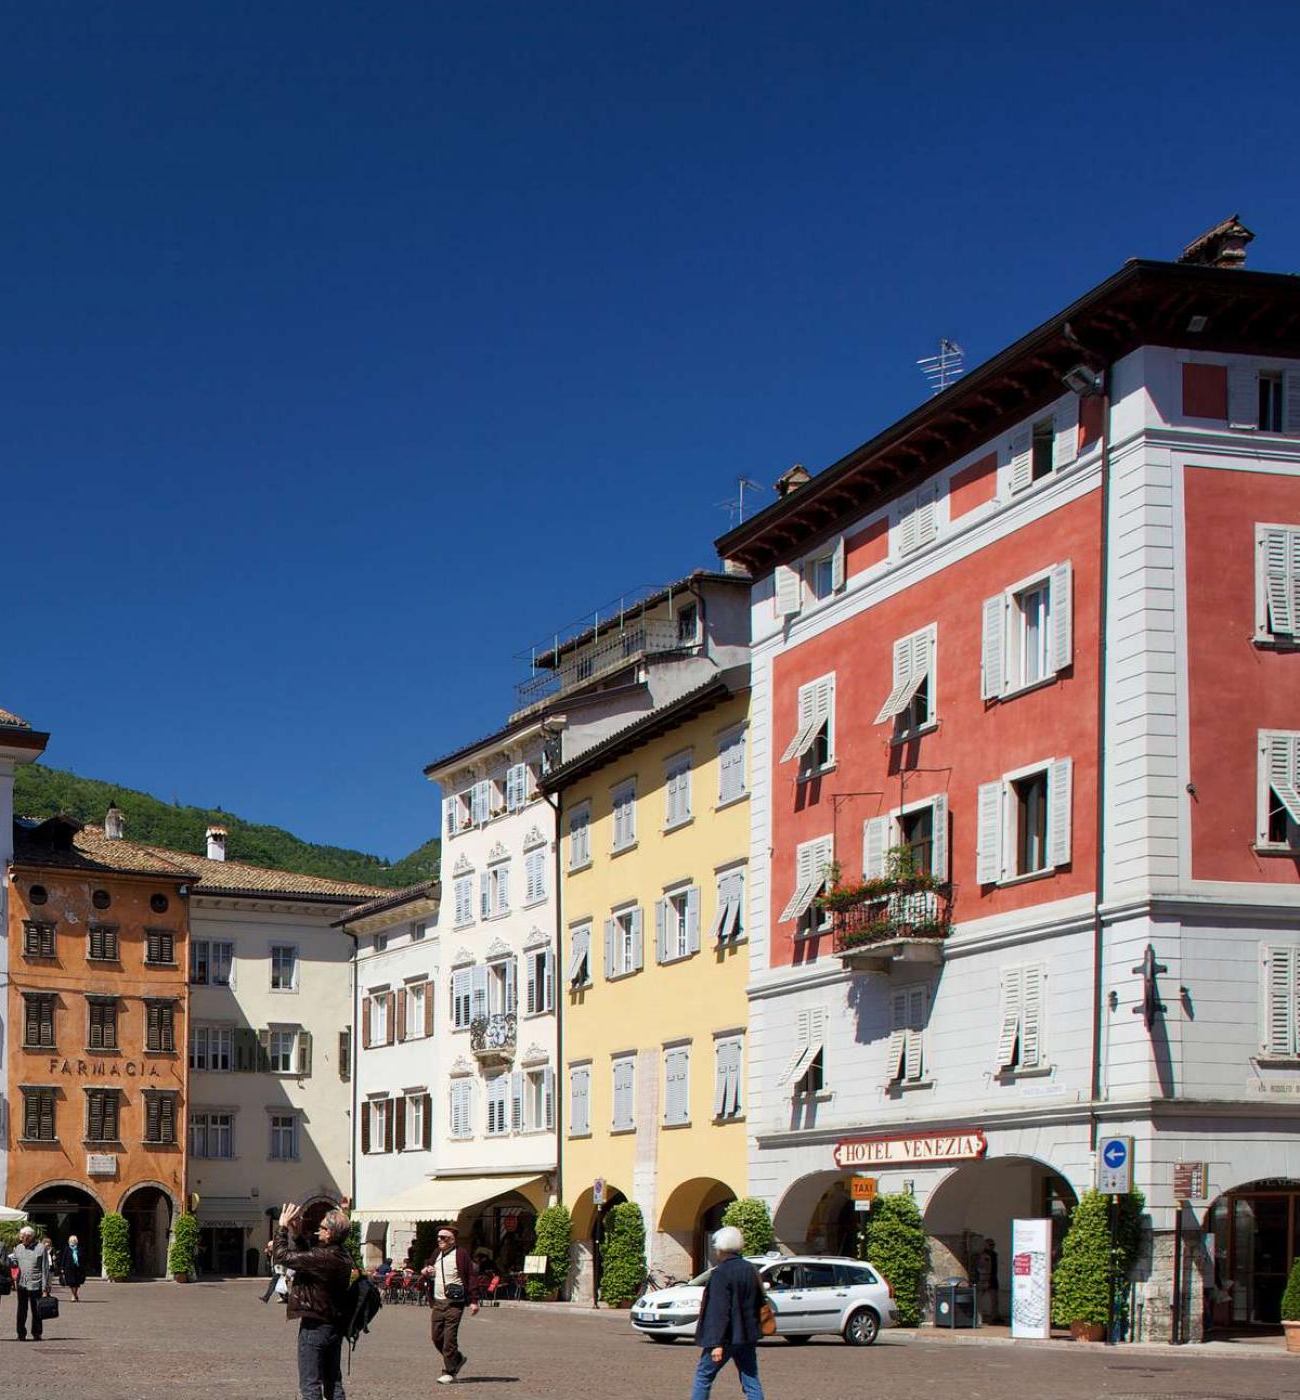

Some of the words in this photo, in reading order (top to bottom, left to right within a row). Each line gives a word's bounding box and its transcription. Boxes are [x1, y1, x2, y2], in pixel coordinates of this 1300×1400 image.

[49, 1058, 160, 1077] FARMACIA
[846, 1142, 893, 1162] HOTEL
[904, 1137, 974, 1158] VENEZIA
[853, 1183, 873, 1193] TAXI
